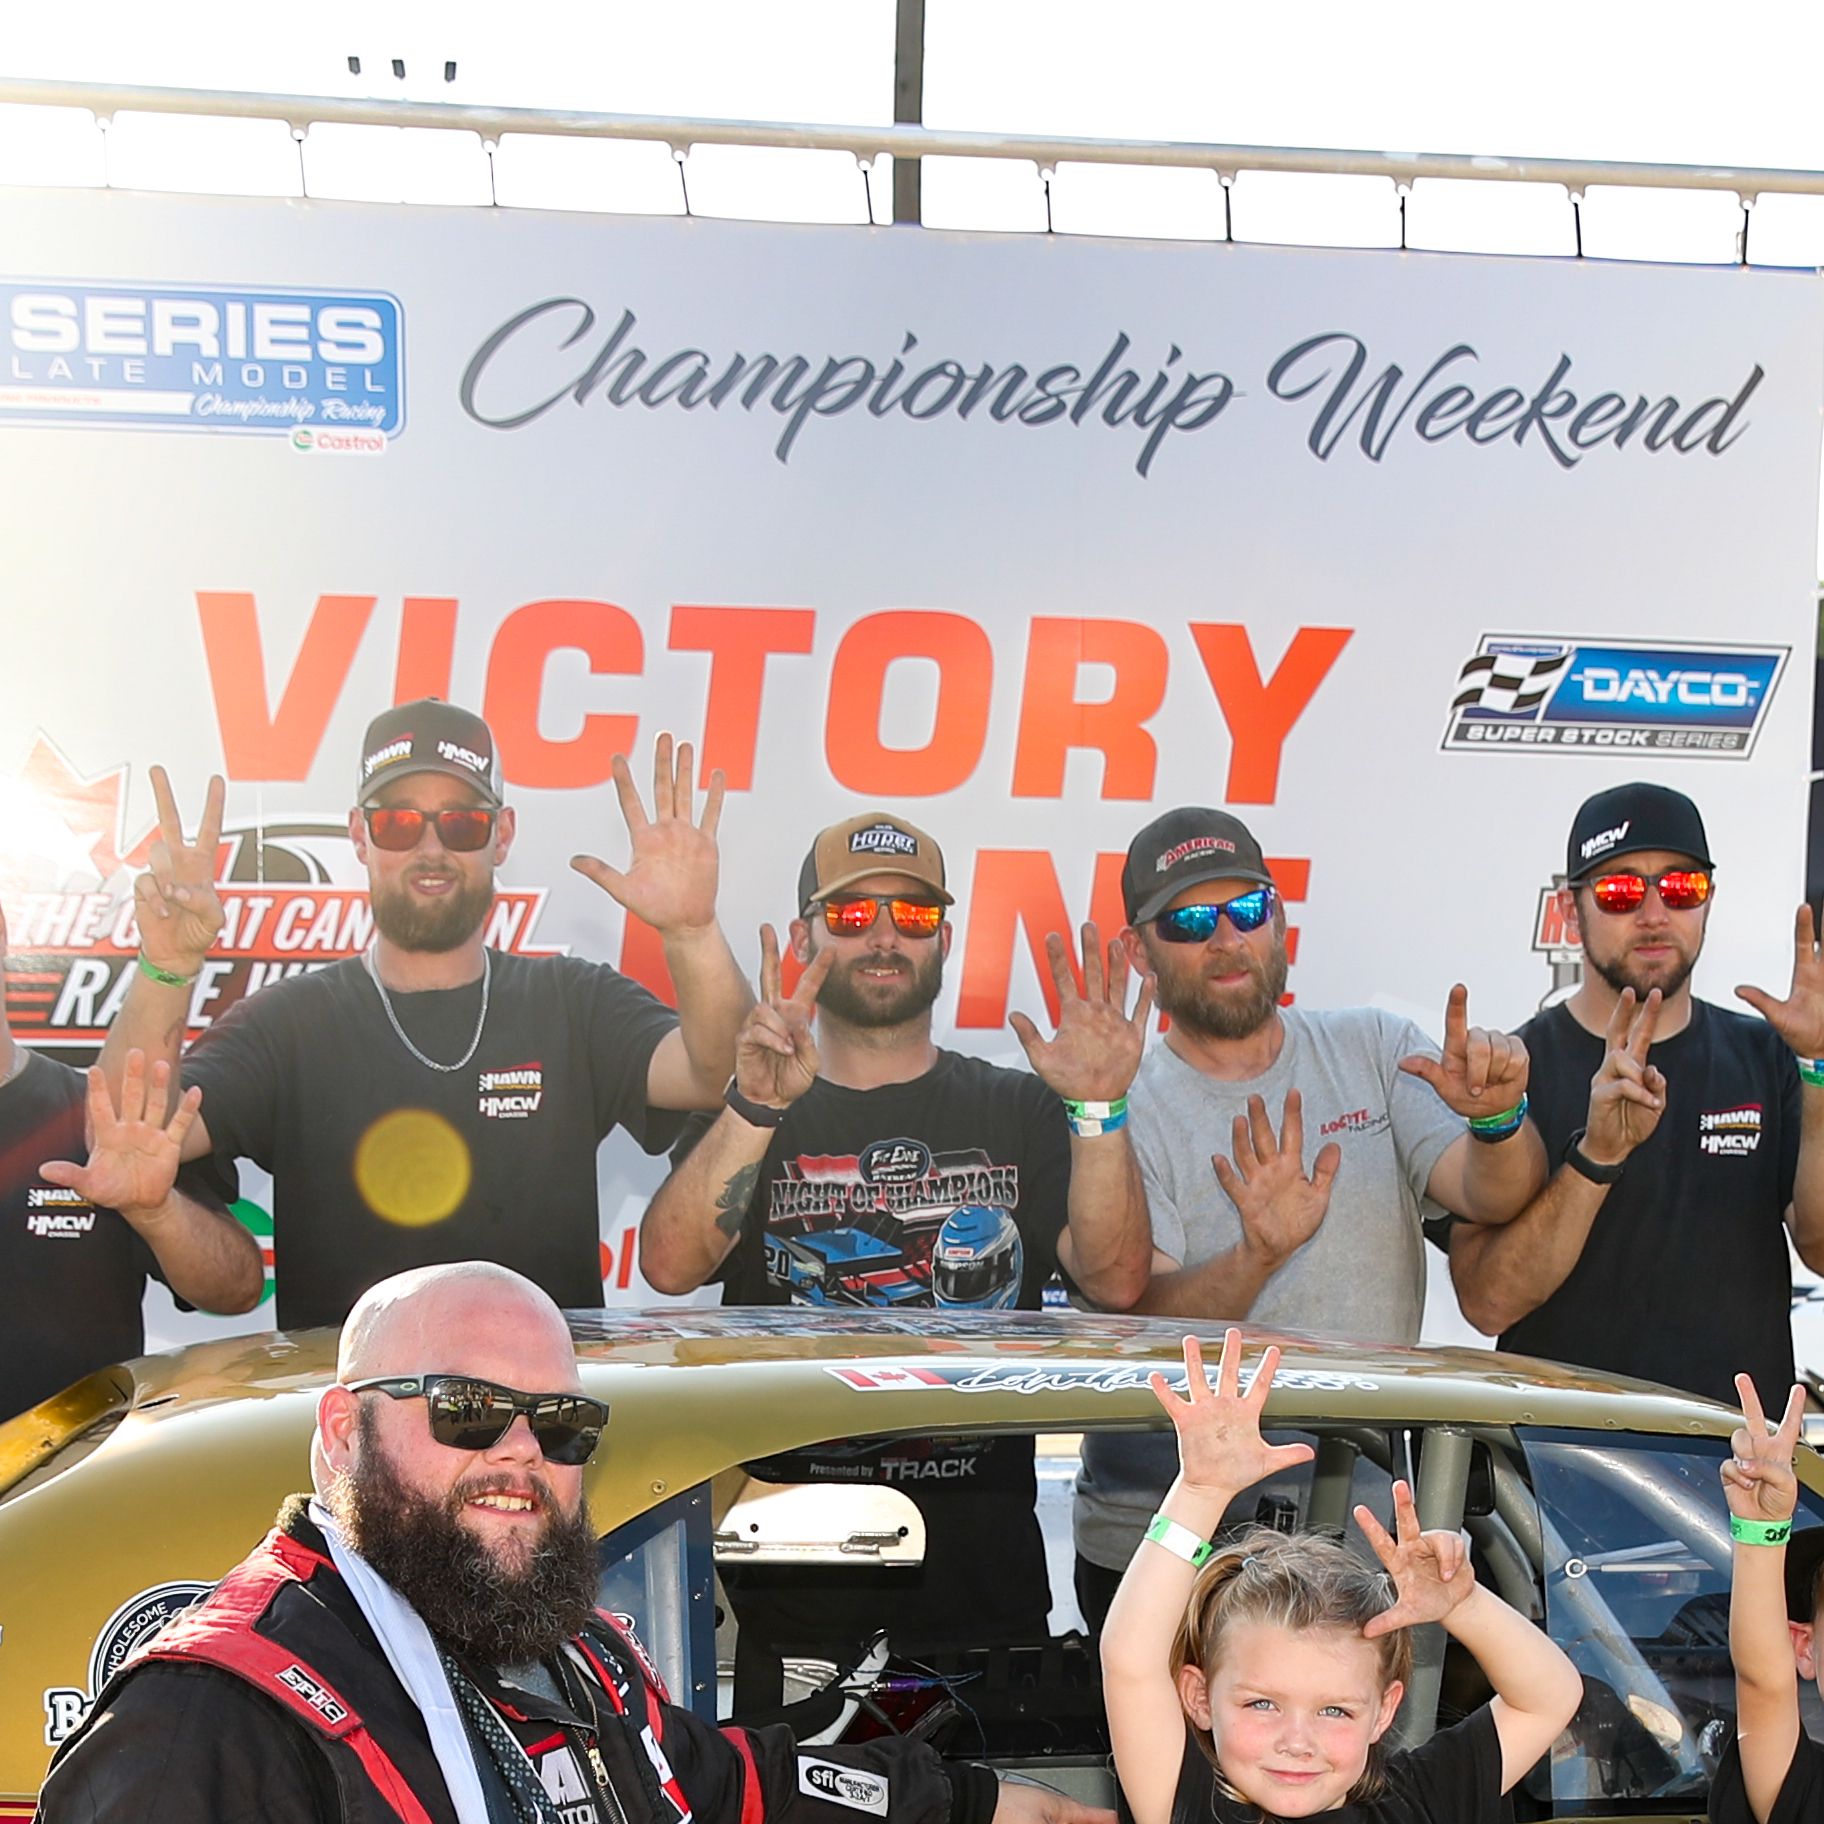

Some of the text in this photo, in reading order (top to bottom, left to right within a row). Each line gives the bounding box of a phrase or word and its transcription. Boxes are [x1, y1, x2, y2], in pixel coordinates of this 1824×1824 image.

[10, 294, 384, 362] SERIES
[12, 357, 386, 393] LATE MODEL
[461, 296, 1766, 478] Championship Weekend
[194, 393, 388, 426] Championship Racing
[317, 433, 384, 453] Castrol
[196, 590, 1356, 806] VICTORY
[1581, 667, 1756, 707] DAYCO
[1466, 725, 1739, 749] SUPER STOCK SERIES
[1164, 837, 1236, 870] AMERICAN
[1580, 821, 1630, 859] HMCW
[11, 893, 98, 948] THE
[109, 895, 266, 950] GAT
[50, 957, 220, 1028] RAE
[479, 1092, 542, 1116] HMCW
[1700, 1132, 1761, 1154] HMCW
[769, 1165, 1019, 1222] NIGHT OF CHAMPIONS
[27, 1212, 96, 1235] HMCW
[810, 1463, 874, 1477] Presented by
[881, 1458, 976, 1481] TRACK
[278, 1668, 346, 1722] EPIC
[812, 1769, 833, 1788] sfi
